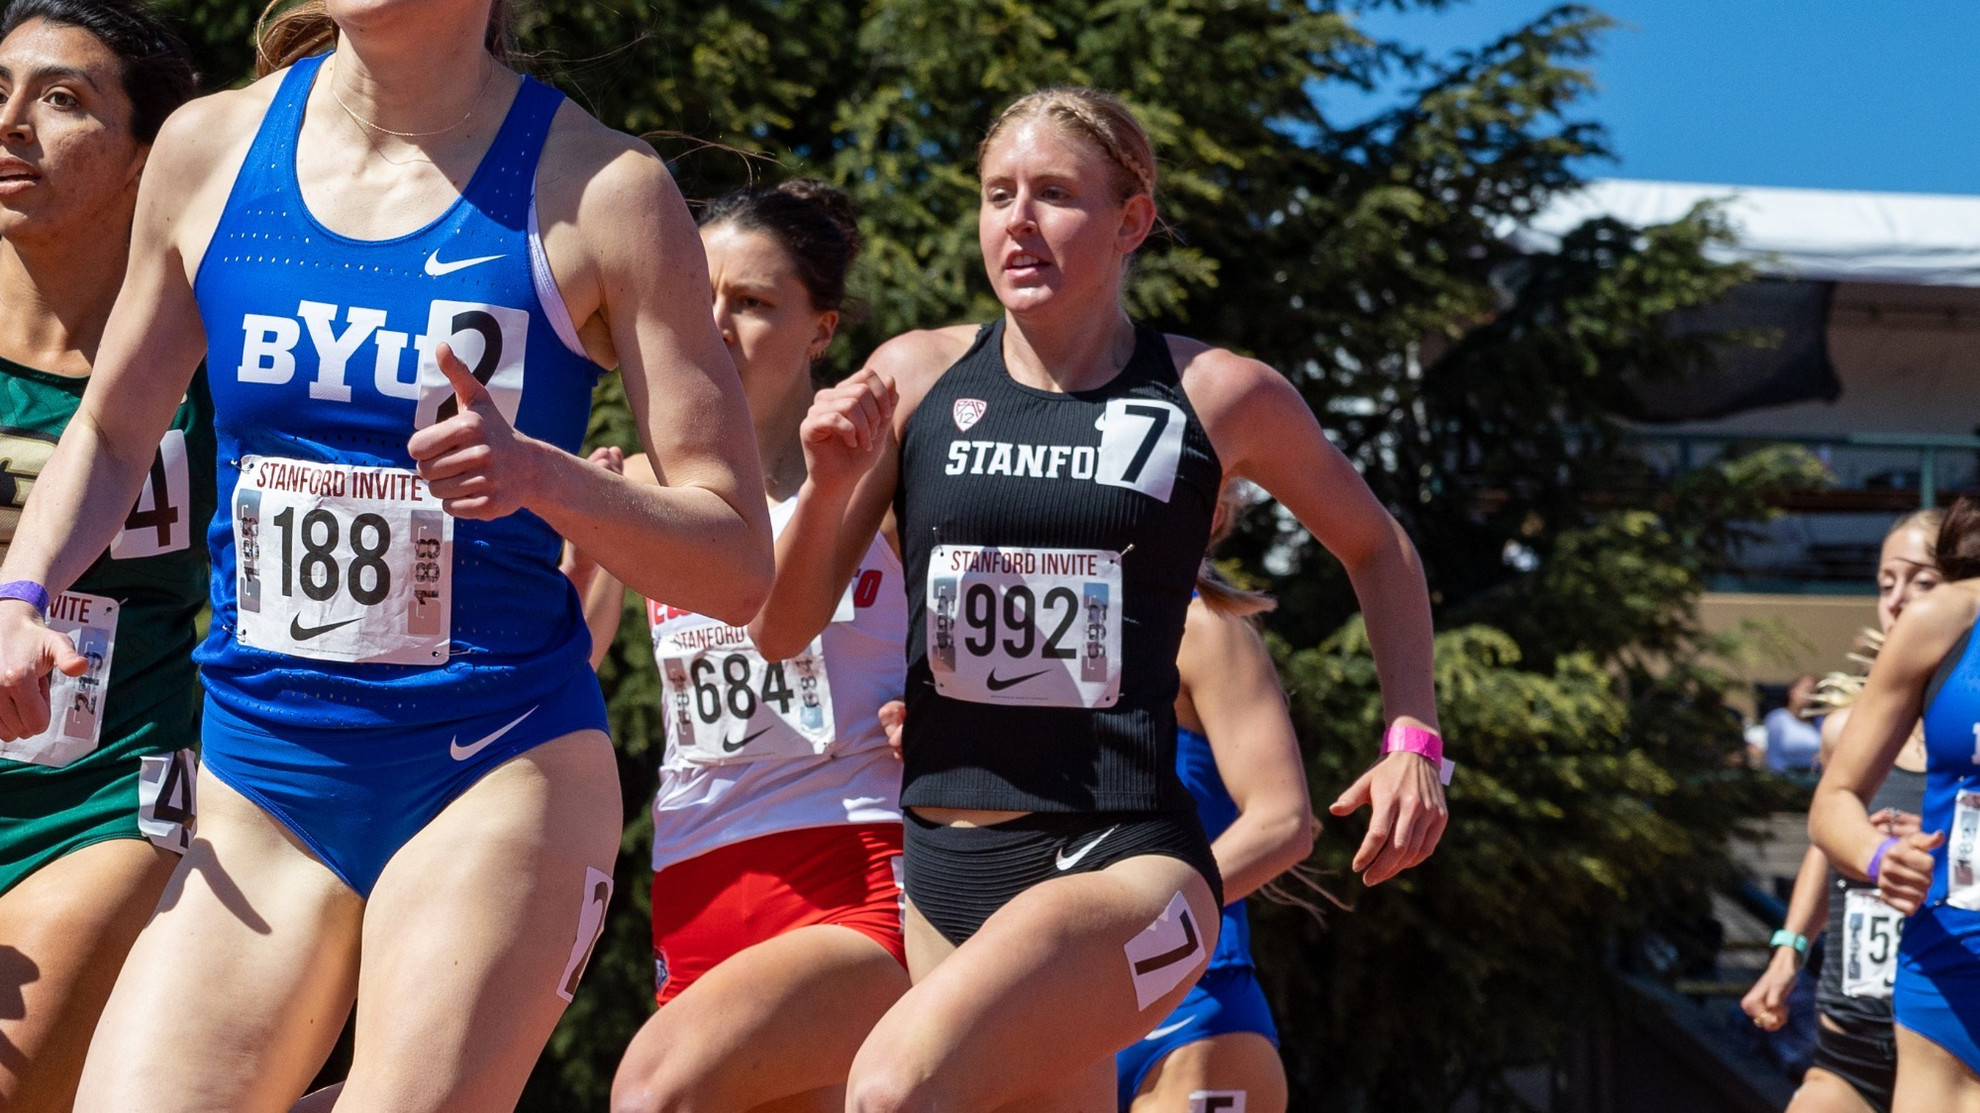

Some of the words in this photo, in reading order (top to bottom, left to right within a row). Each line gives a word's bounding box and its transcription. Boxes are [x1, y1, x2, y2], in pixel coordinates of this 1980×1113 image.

[237, 299, 427, 402] BYU
[958, 412, 975, 425] 12
[1120, 404, 1171, 484] 7
[256, 461, 346, 497] STANFORD
[352, 471, 424, 502] INVITE
[945, 440, 1102, 480] STANFO
[124, 443, 178, 547] 4
[273, 505, 391, 607] 188
[414, 538, 441, 605] 188
[950, 550, 1036, 575] STANFORD
[1041, 553, 1098, 576] INVITE
[50, 595, 93, 624] VITE
[672, 625, 745, 651] STANFORD
[965, 583, 1079, 660] 992
[690, 653, 794, 725] 684
[153, 750, 197, 850] 4
[1133, 909, 1199, 976] 7
